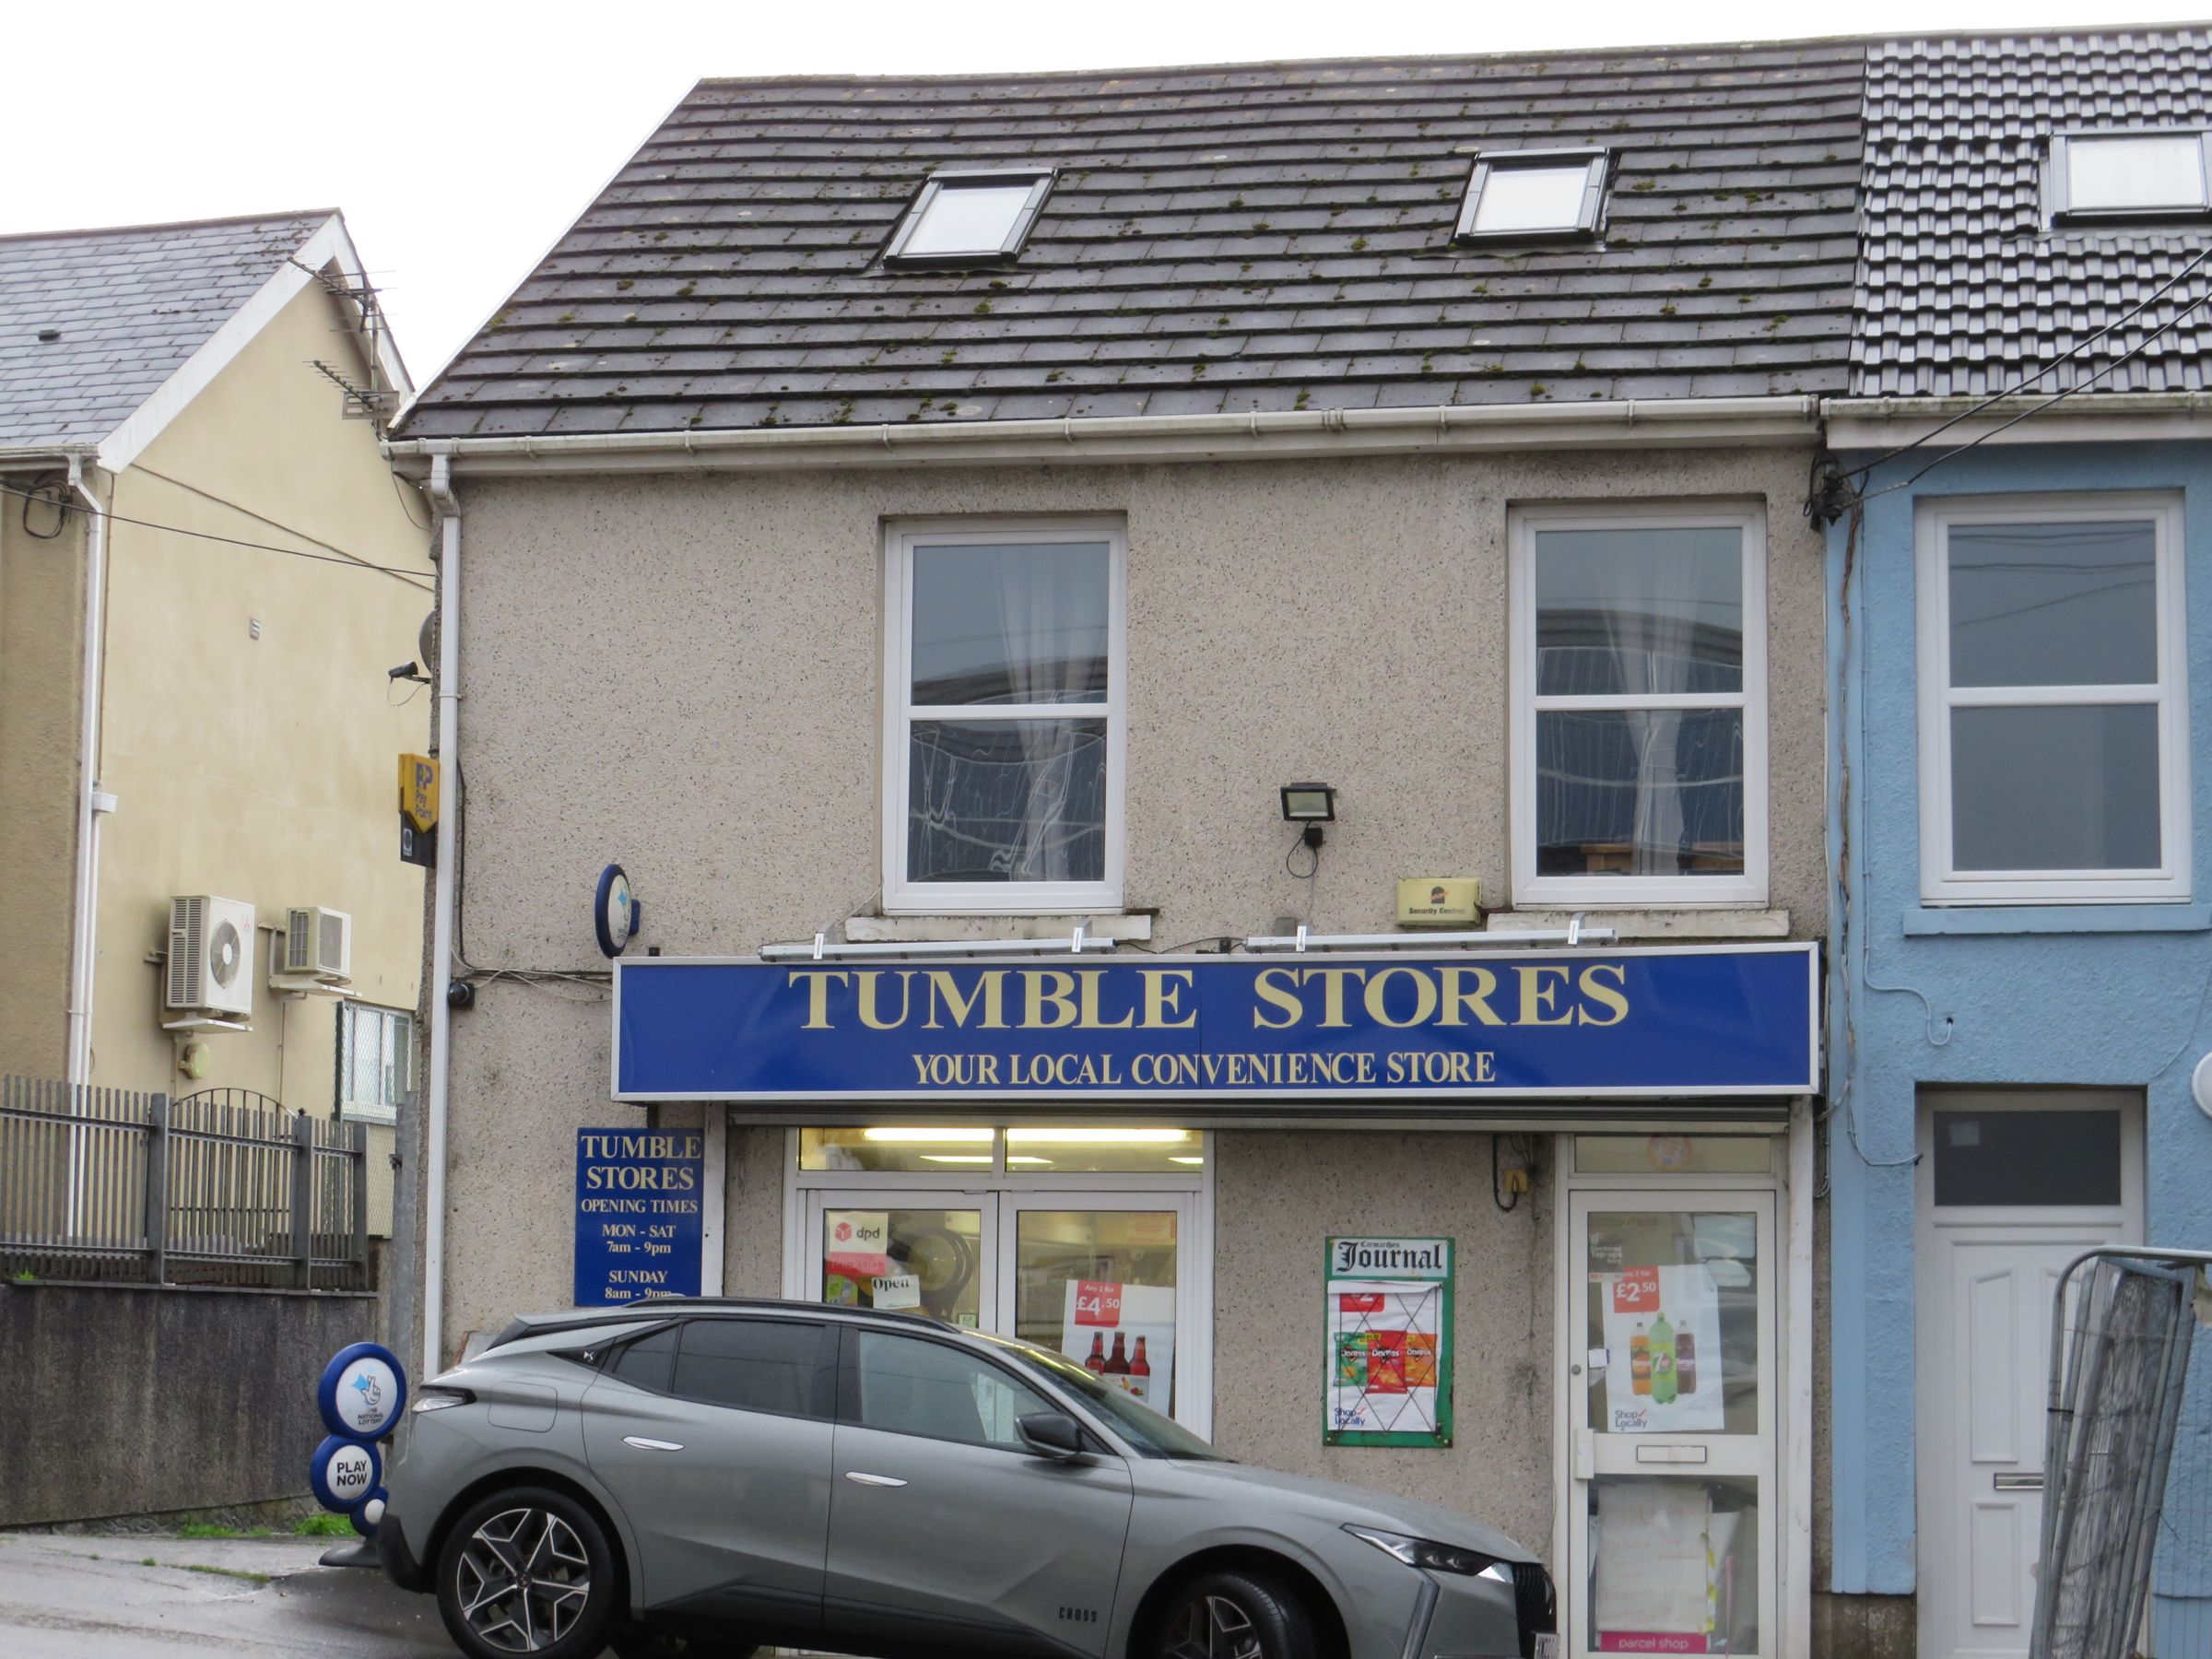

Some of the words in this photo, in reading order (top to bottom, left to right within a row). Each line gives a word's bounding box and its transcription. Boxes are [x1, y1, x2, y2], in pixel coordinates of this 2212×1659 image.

[788, 970, 1197, 1030] TUMBLE
[1253, 964, 1630, 1029] STORES
[912, 1053, 999, 1085] YOUR
[1010, 1053, 1122, 1085] LOCAL
[1132, 1052, 1376, 1085] CONVENIENCE
[1386, 1051, 1496, 1084] STORE
[581, 1135, 701, 1159] TUMBLE
[586, 1166, 694, 1190] STORES
[581, 1199, 646, 1213] OPENING
[650, 1200, 698, 1214] TIMES
[602, 1224, 636, 1237] MON
[649, 1225, 677, 1238] SAT
[856, 1228, 880, 1241] dpd
[606, 1241, 631, 1253] 7am
[644, 1242, 671, 1256] 9pm
[1335, 1241, 1442, 1272] Journal
[608, 1270, 668, 1284] SUNDAY
[873, 1278, 909, 1291] Open
[605, 1288, 631, 1299] 8am
[358, 1412, 383, 1420] NATIONAL
[1335, 1407, 1357, 1417] Shop
[1615, 1409, 1638, 1419] Shop
[358, 1418, 382, 1426] LOTTERY
[1335, 1417, 1365, 1427] Locally
[1615, 1418, 1647, 1429] Locally
[337, 1460, 367, 1474] PLAY
[337, 1474, 367, 1486] NOW
[1059, 1606, 1097, 1623] CROSS
[1618, 1638, 1656, 1649] parcel
[1659, 1639, 1688, 1650] shop
